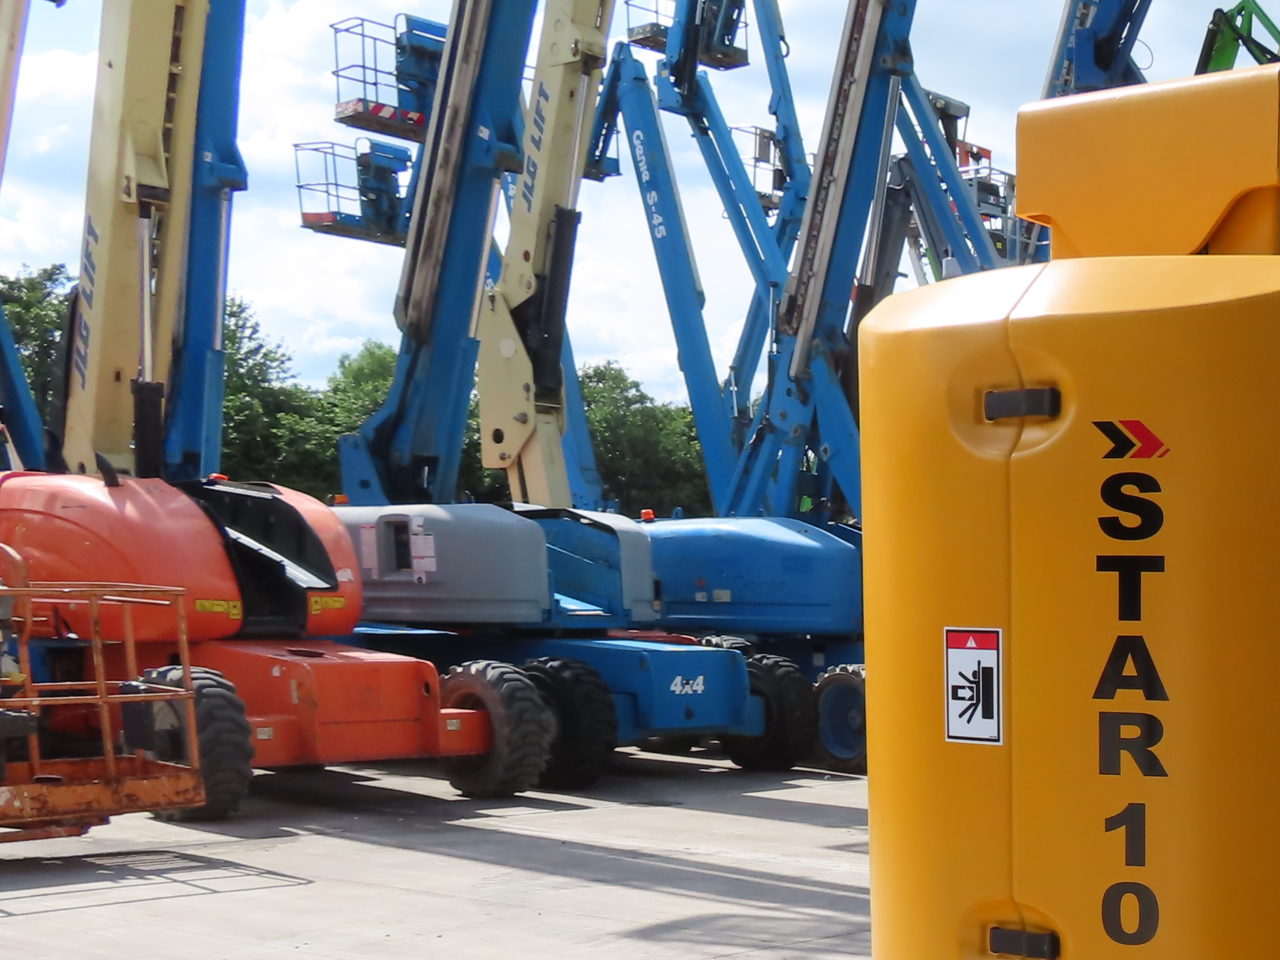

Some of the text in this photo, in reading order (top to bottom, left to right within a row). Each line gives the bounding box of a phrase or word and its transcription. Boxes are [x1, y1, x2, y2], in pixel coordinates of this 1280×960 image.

[521, 80, 551, 213] JLG LIFT
[632, 129, 667, 239] Genie S-45
[74, 215, 99, 391] JLG LIFT
[669, 675, 705, 695] 4x4
[1091, 471, 1170, 946] STAR 10
